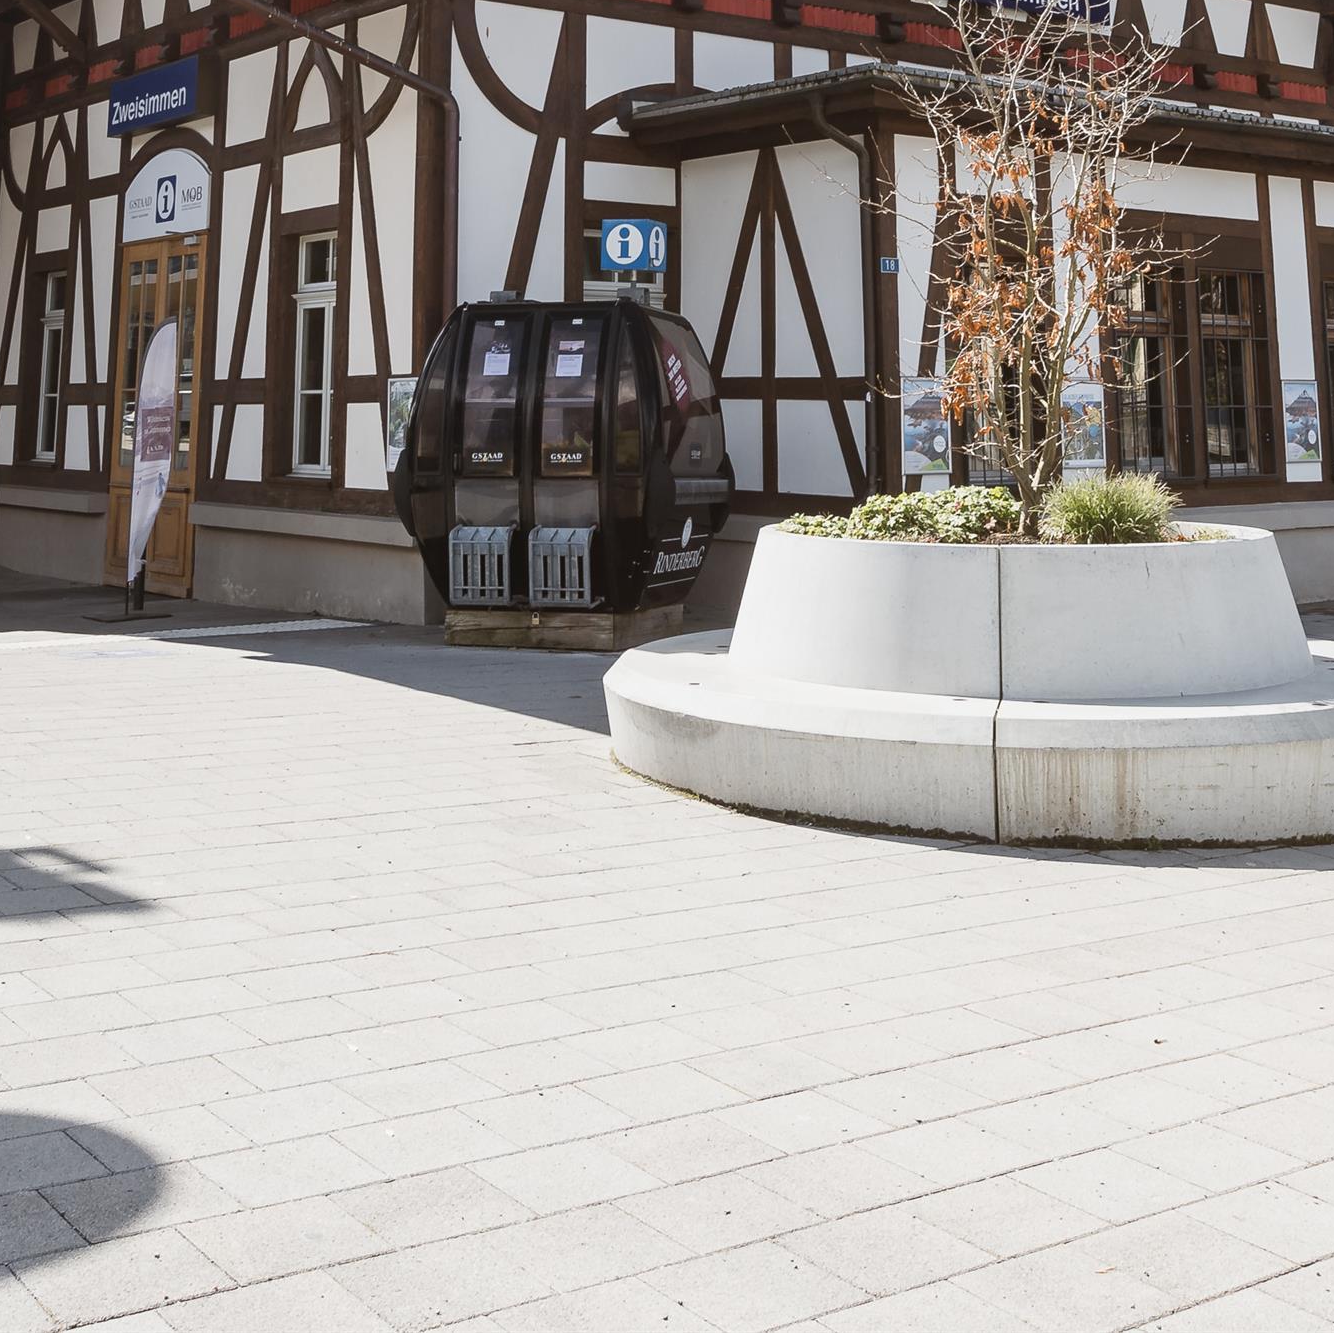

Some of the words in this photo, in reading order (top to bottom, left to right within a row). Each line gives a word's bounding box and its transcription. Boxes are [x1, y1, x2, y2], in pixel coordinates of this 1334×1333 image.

[111, 86, 187, 125] Zweisimmen
[181, 186, 203, 204] MOB
[886, 259, 895, 271] 18
[472, 452, 503, 460] GSTAAD
